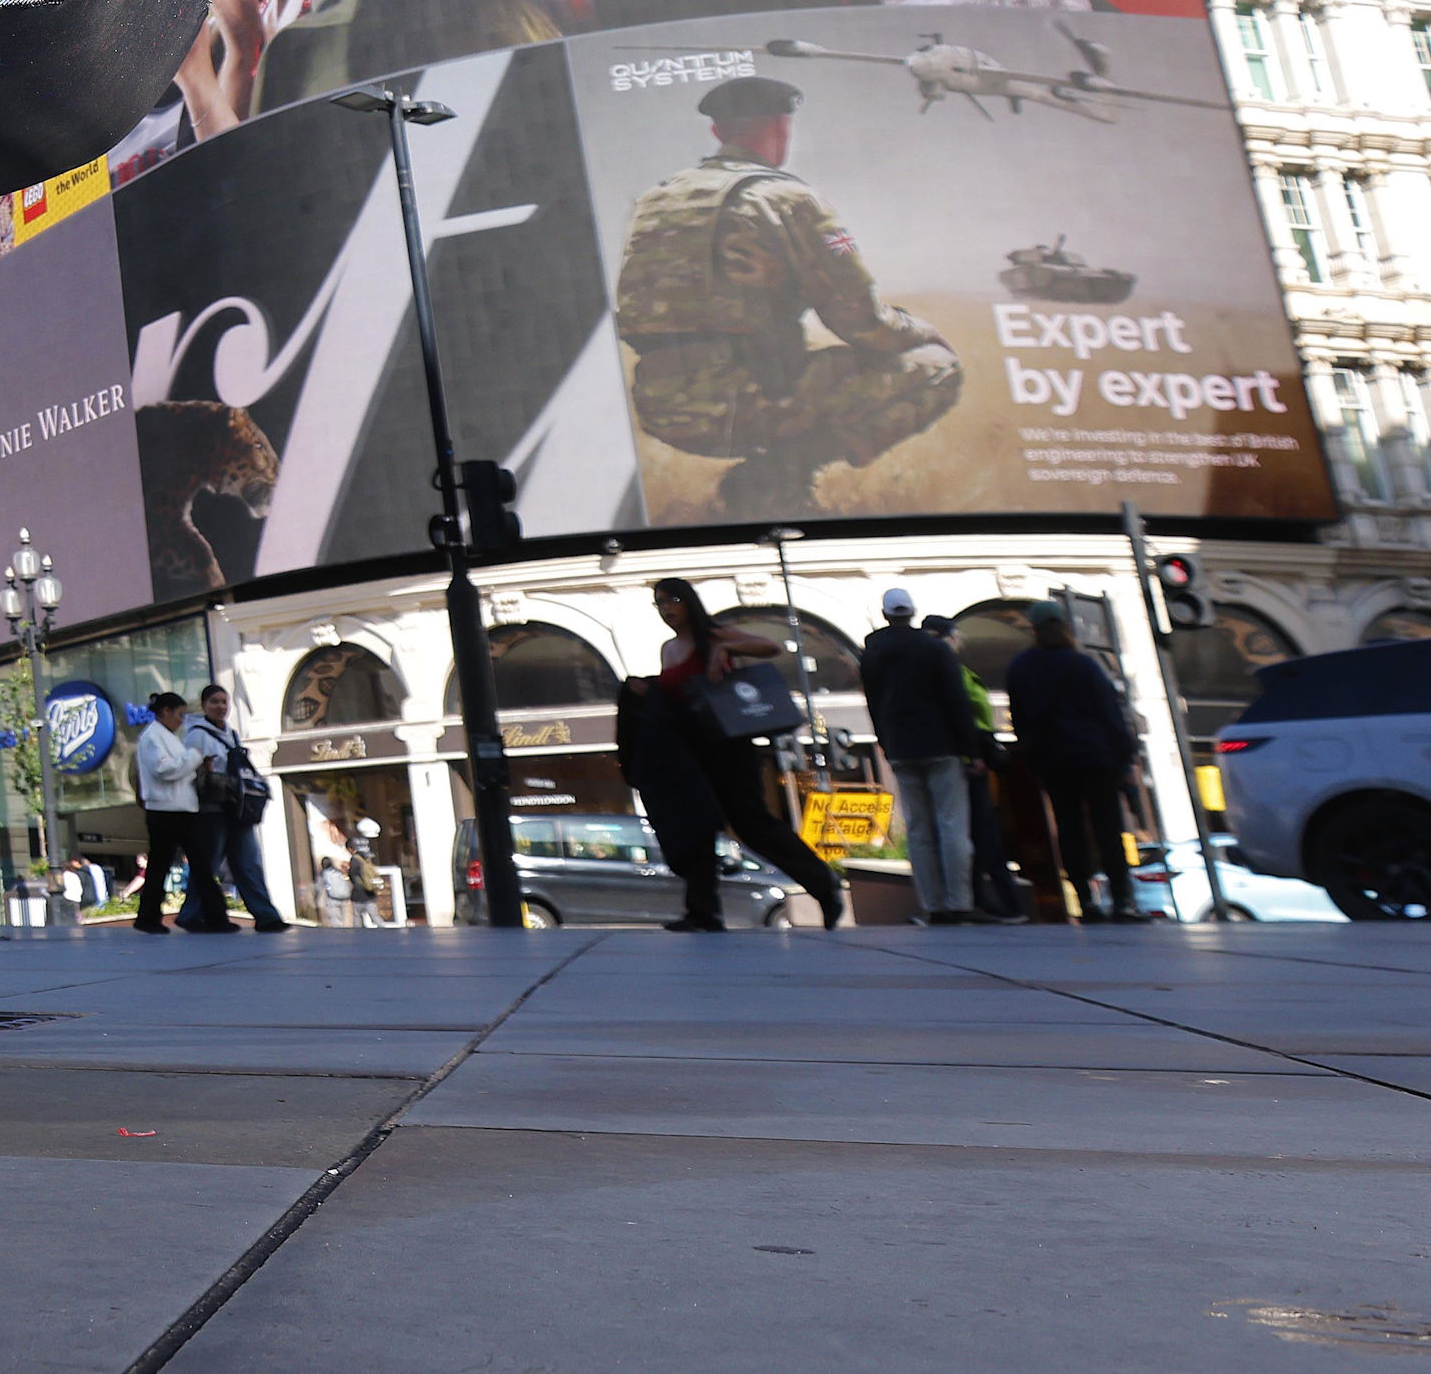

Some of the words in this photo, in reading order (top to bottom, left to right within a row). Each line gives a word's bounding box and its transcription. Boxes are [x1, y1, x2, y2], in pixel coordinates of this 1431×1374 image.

[609, 49, 755, 77] QUANTUM
[610, 62, 757, 92] SYSTEMS
[23, 181, 44, 209] LEGO
[55, 180, 71, 195] the
[70, 160, 100, 186] World
[992, 302, 1193, 360] Expert
[1004, 355, 1085, 417] by
[1098, 369, 1289, 420] expert
[36, 383, 126, 441] WALKER
